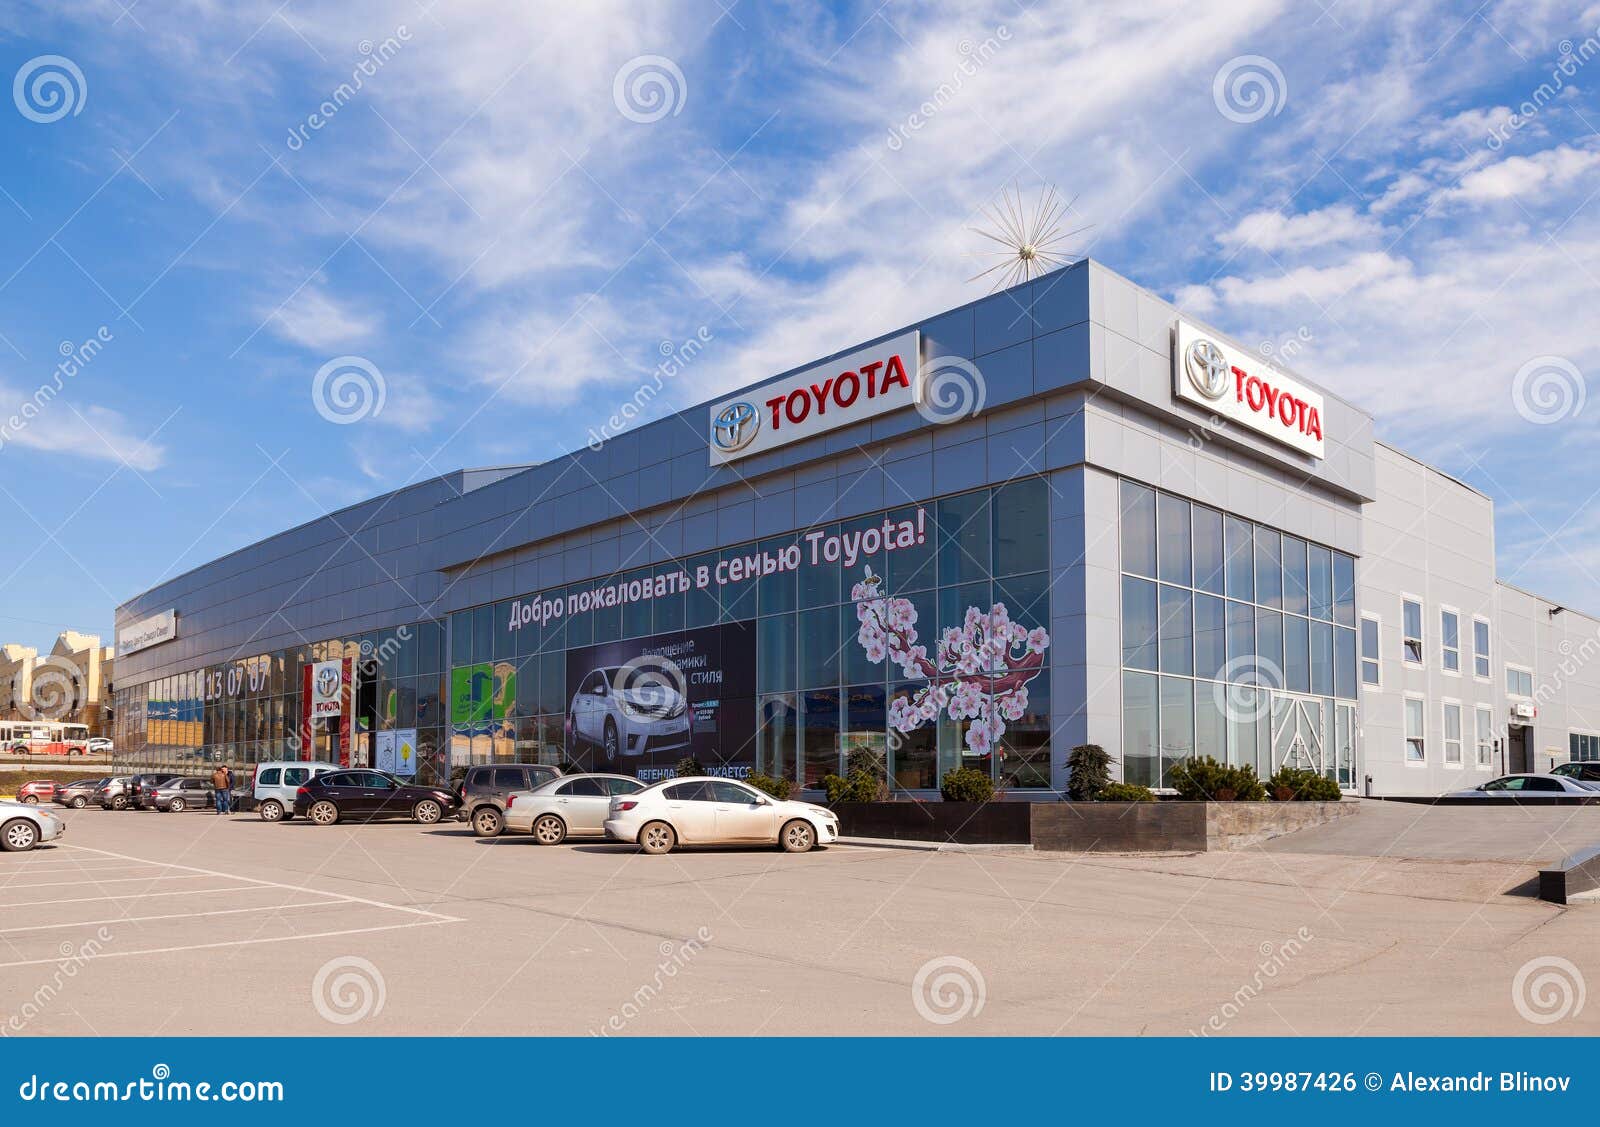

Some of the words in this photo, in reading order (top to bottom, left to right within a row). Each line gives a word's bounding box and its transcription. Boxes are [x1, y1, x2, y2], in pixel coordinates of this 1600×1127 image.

[766, 354, 910, 430] TOYOTA
[1231, 365, 1323, 441] TOYOTA
[508, 593, 564, 632] Добро
[567, 570, 691, 615] пожаловать
[696, 565, 710, 589] в
[715, 545, 801, 586] семью
[805, 507, 926, 567] Toyota!
[206, 671, 223, 700] 13
[227, 667, 243, 697] 07
[250, 662, 268, 692] 07
[316, 702, 340, 712] TOYOTA
[638, 768, 674, 780] ЛЕГЕНДА
